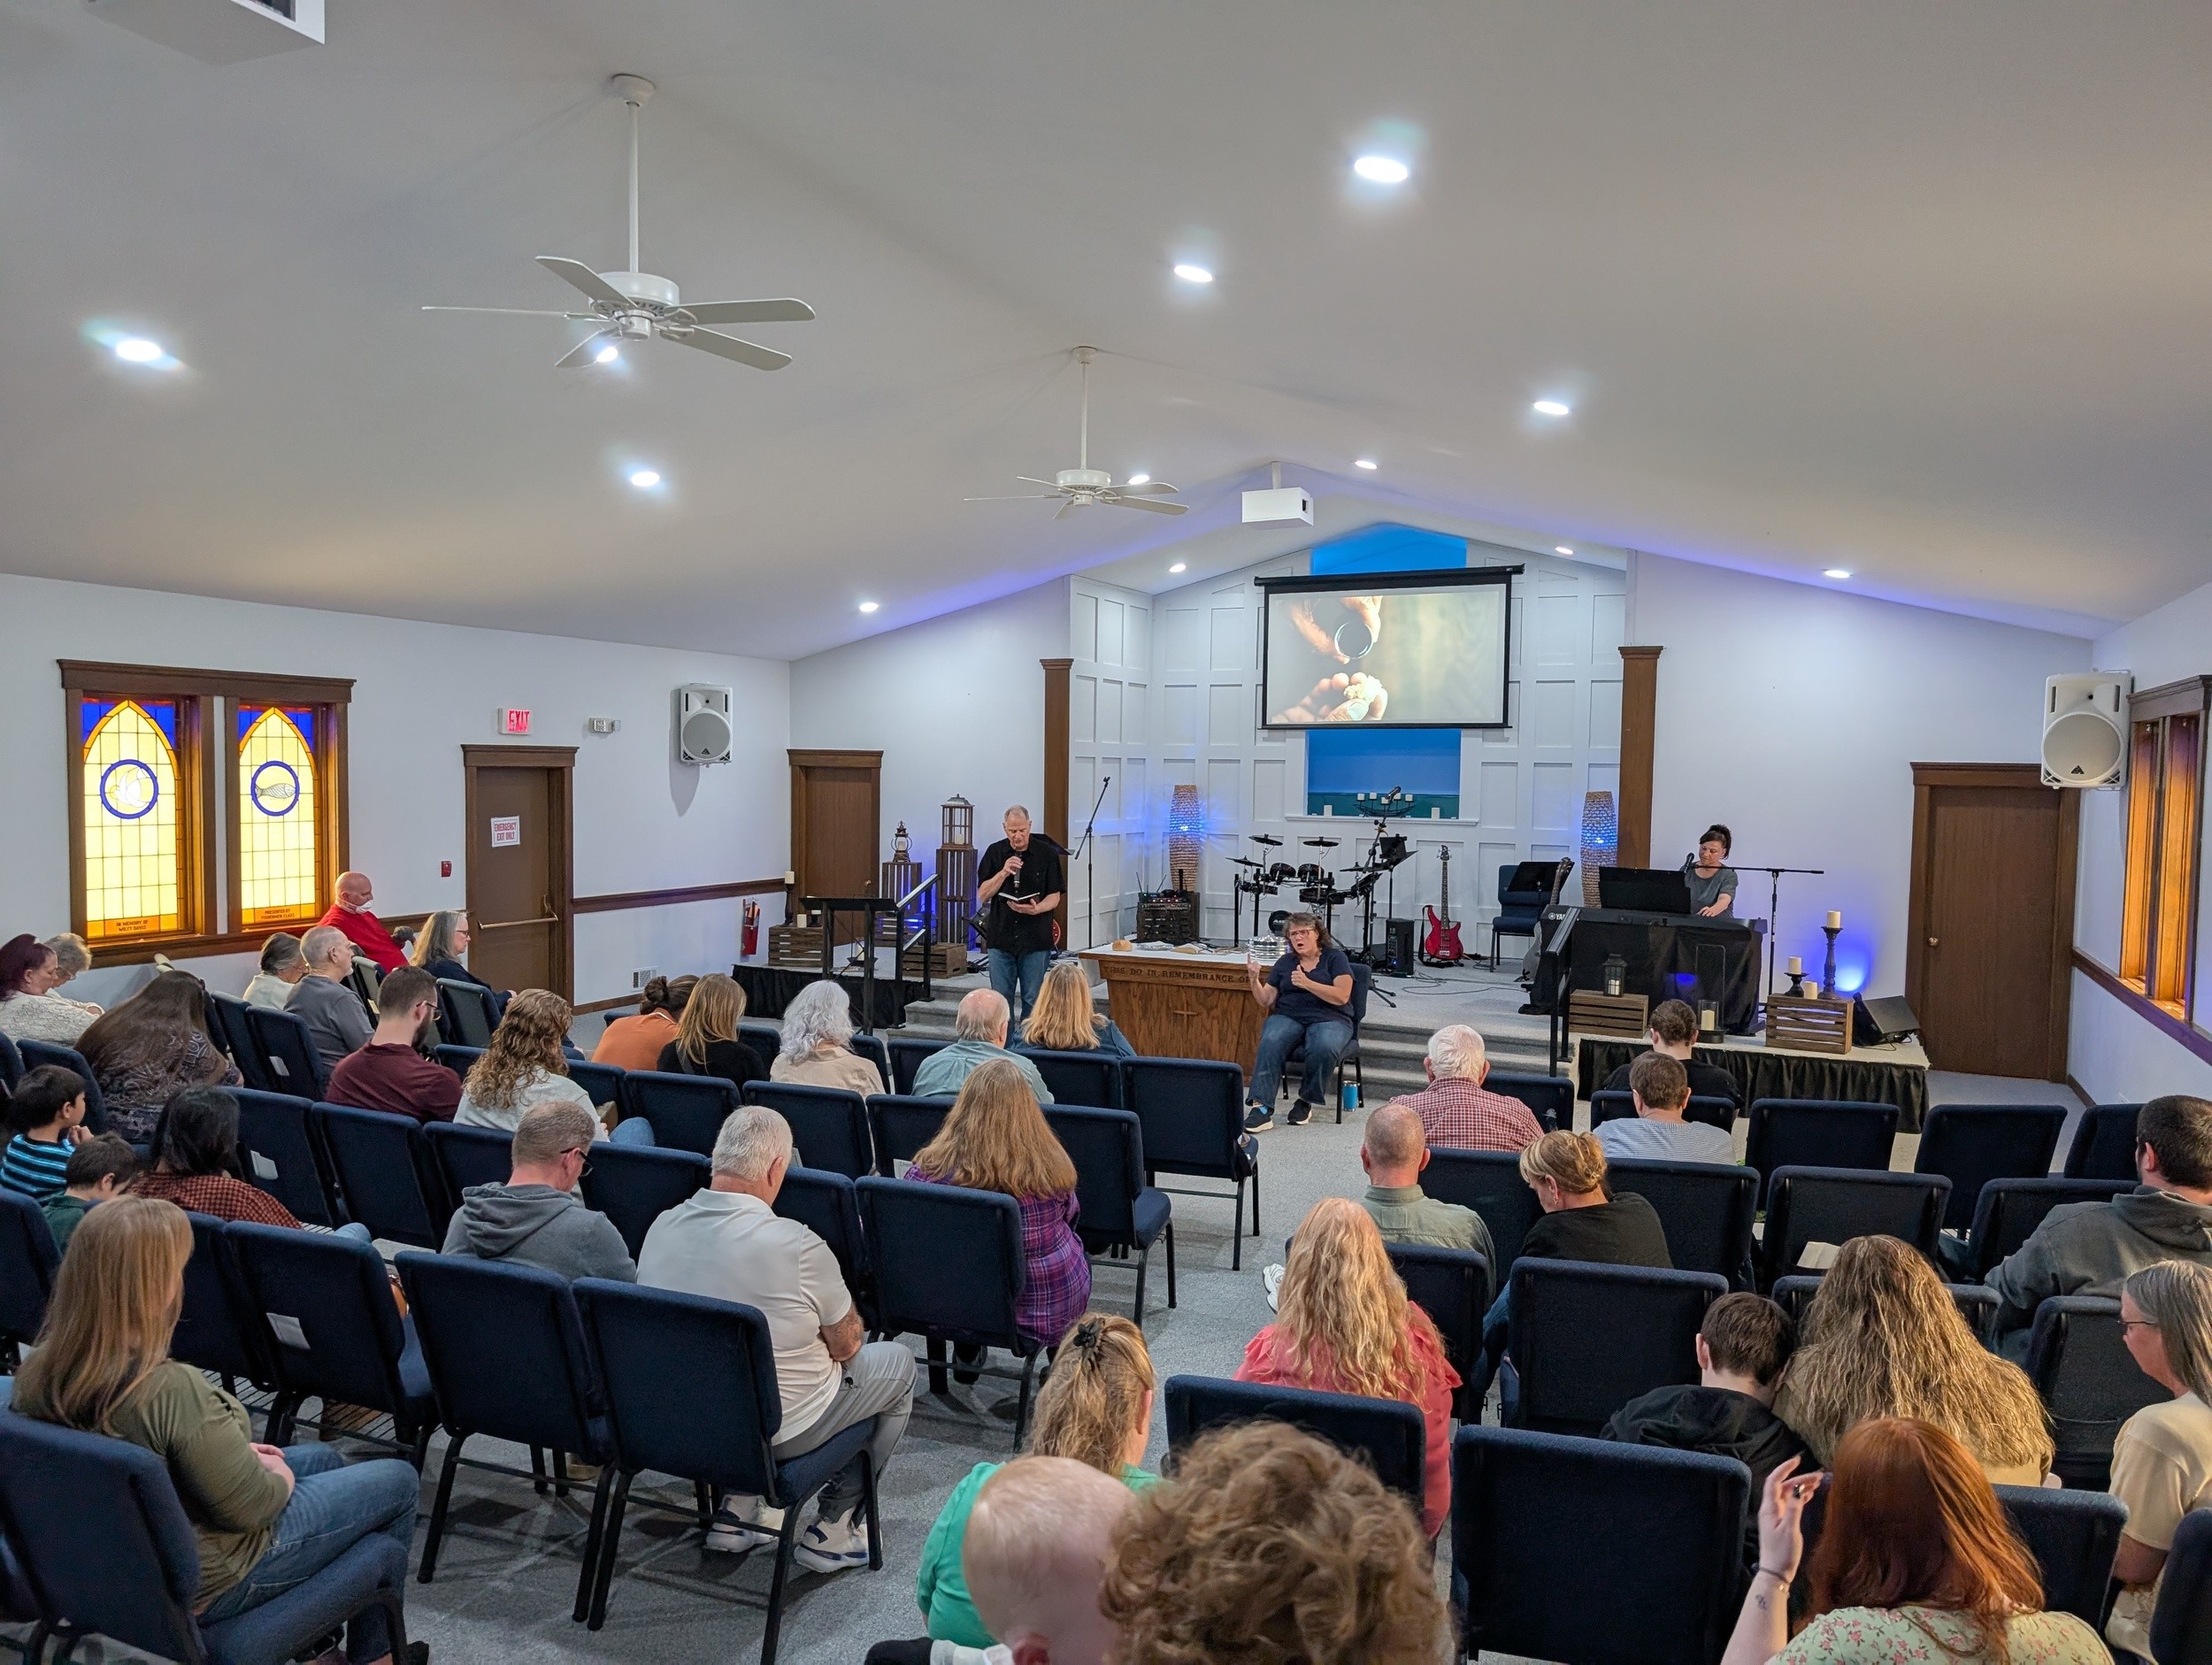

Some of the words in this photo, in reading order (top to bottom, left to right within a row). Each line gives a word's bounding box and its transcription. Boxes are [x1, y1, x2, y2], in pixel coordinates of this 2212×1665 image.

[509, 710, 529, 732] EXIT
[495, 823, 516, 832] EMERGENCY
[496, 832, 505, 841] EXIT
[1163, 971, 1233, 982] REMEMBRANCE
